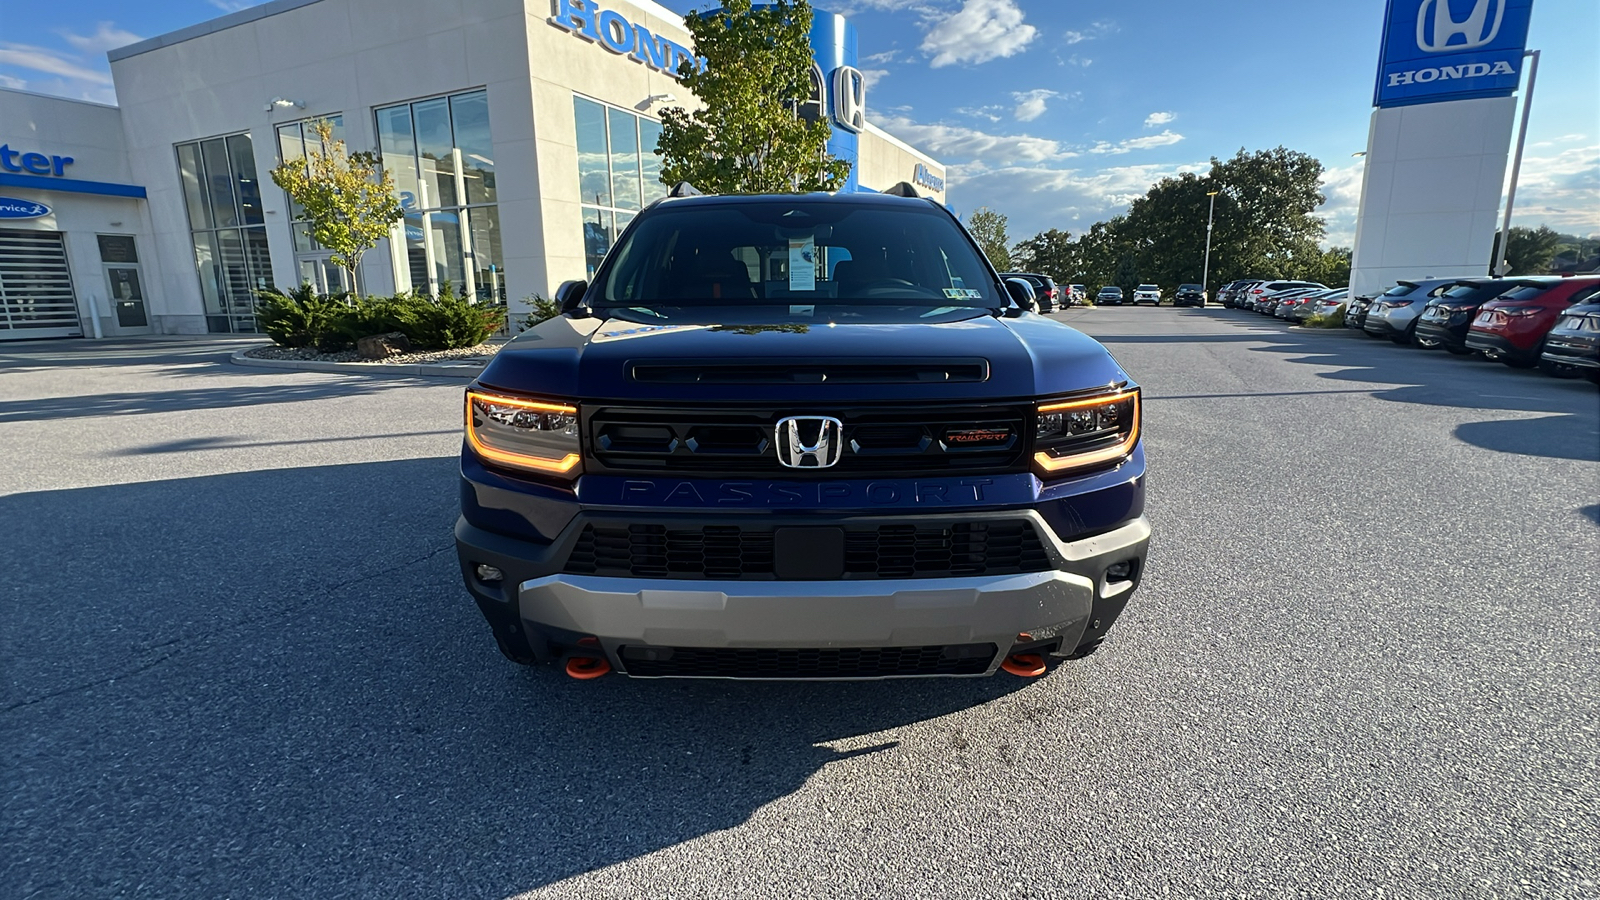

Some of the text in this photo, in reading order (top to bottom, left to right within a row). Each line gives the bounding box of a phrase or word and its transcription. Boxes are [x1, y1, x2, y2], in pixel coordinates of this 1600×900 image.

[547, 0, 708, 79] HOND
[1387, 61, 1515, 87] HONDA
[947, 434, 1008, 442] TRAILSPORT
[621, 479, 994, 503] PASSPORT
